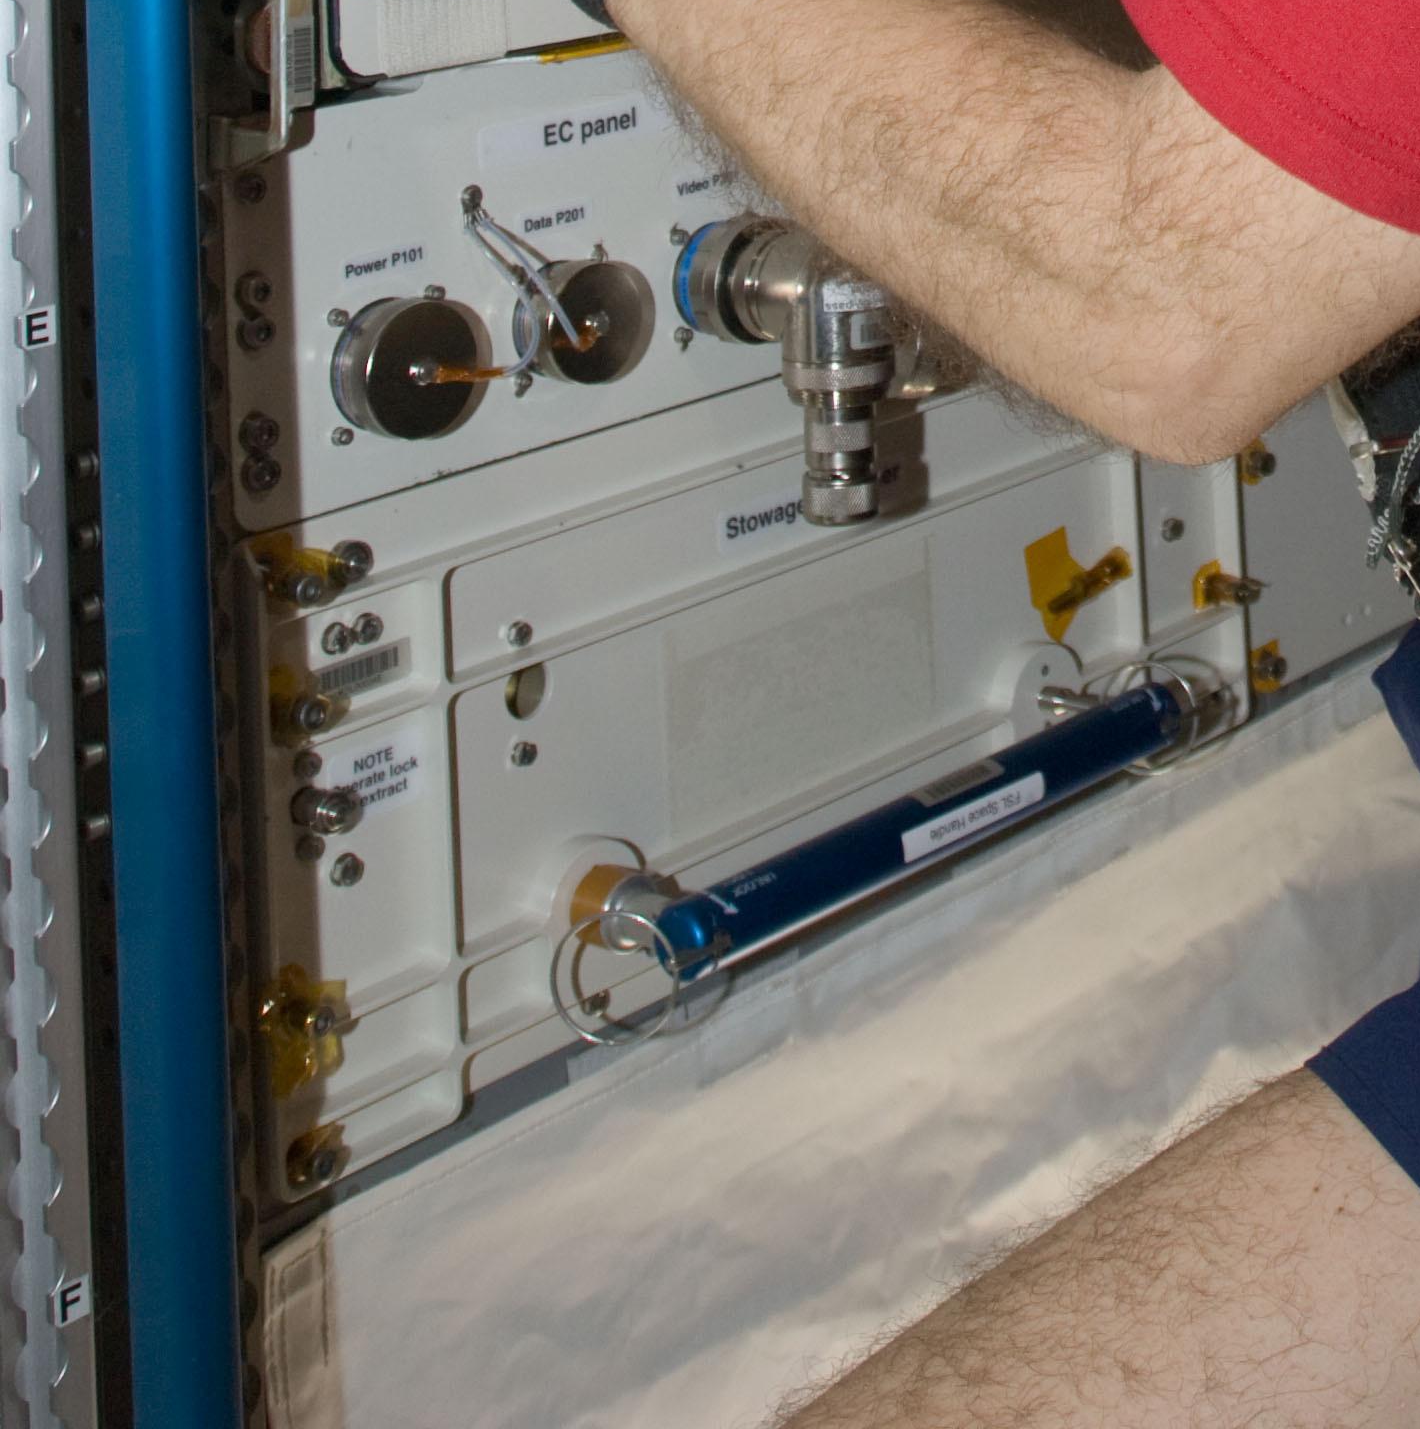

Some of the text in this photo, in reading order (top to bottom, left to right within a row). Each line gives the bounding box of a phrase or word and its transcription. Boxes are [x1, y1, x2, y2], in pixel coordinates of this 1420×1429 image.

[543, 107, 637, 147] EC panel
[676, 180, 709, 196] Video
[524, 206, 585, 234] Data P201
[344, 246, 425, 279] Power P101
[25, 310, 49, 345] E
[353, 746, 394, 774] NOTE
[389, 756, 419, 779] lock
[929, 790, 1022, 841] FSL Space Handle
[58, 1281, 83, 1323] F
